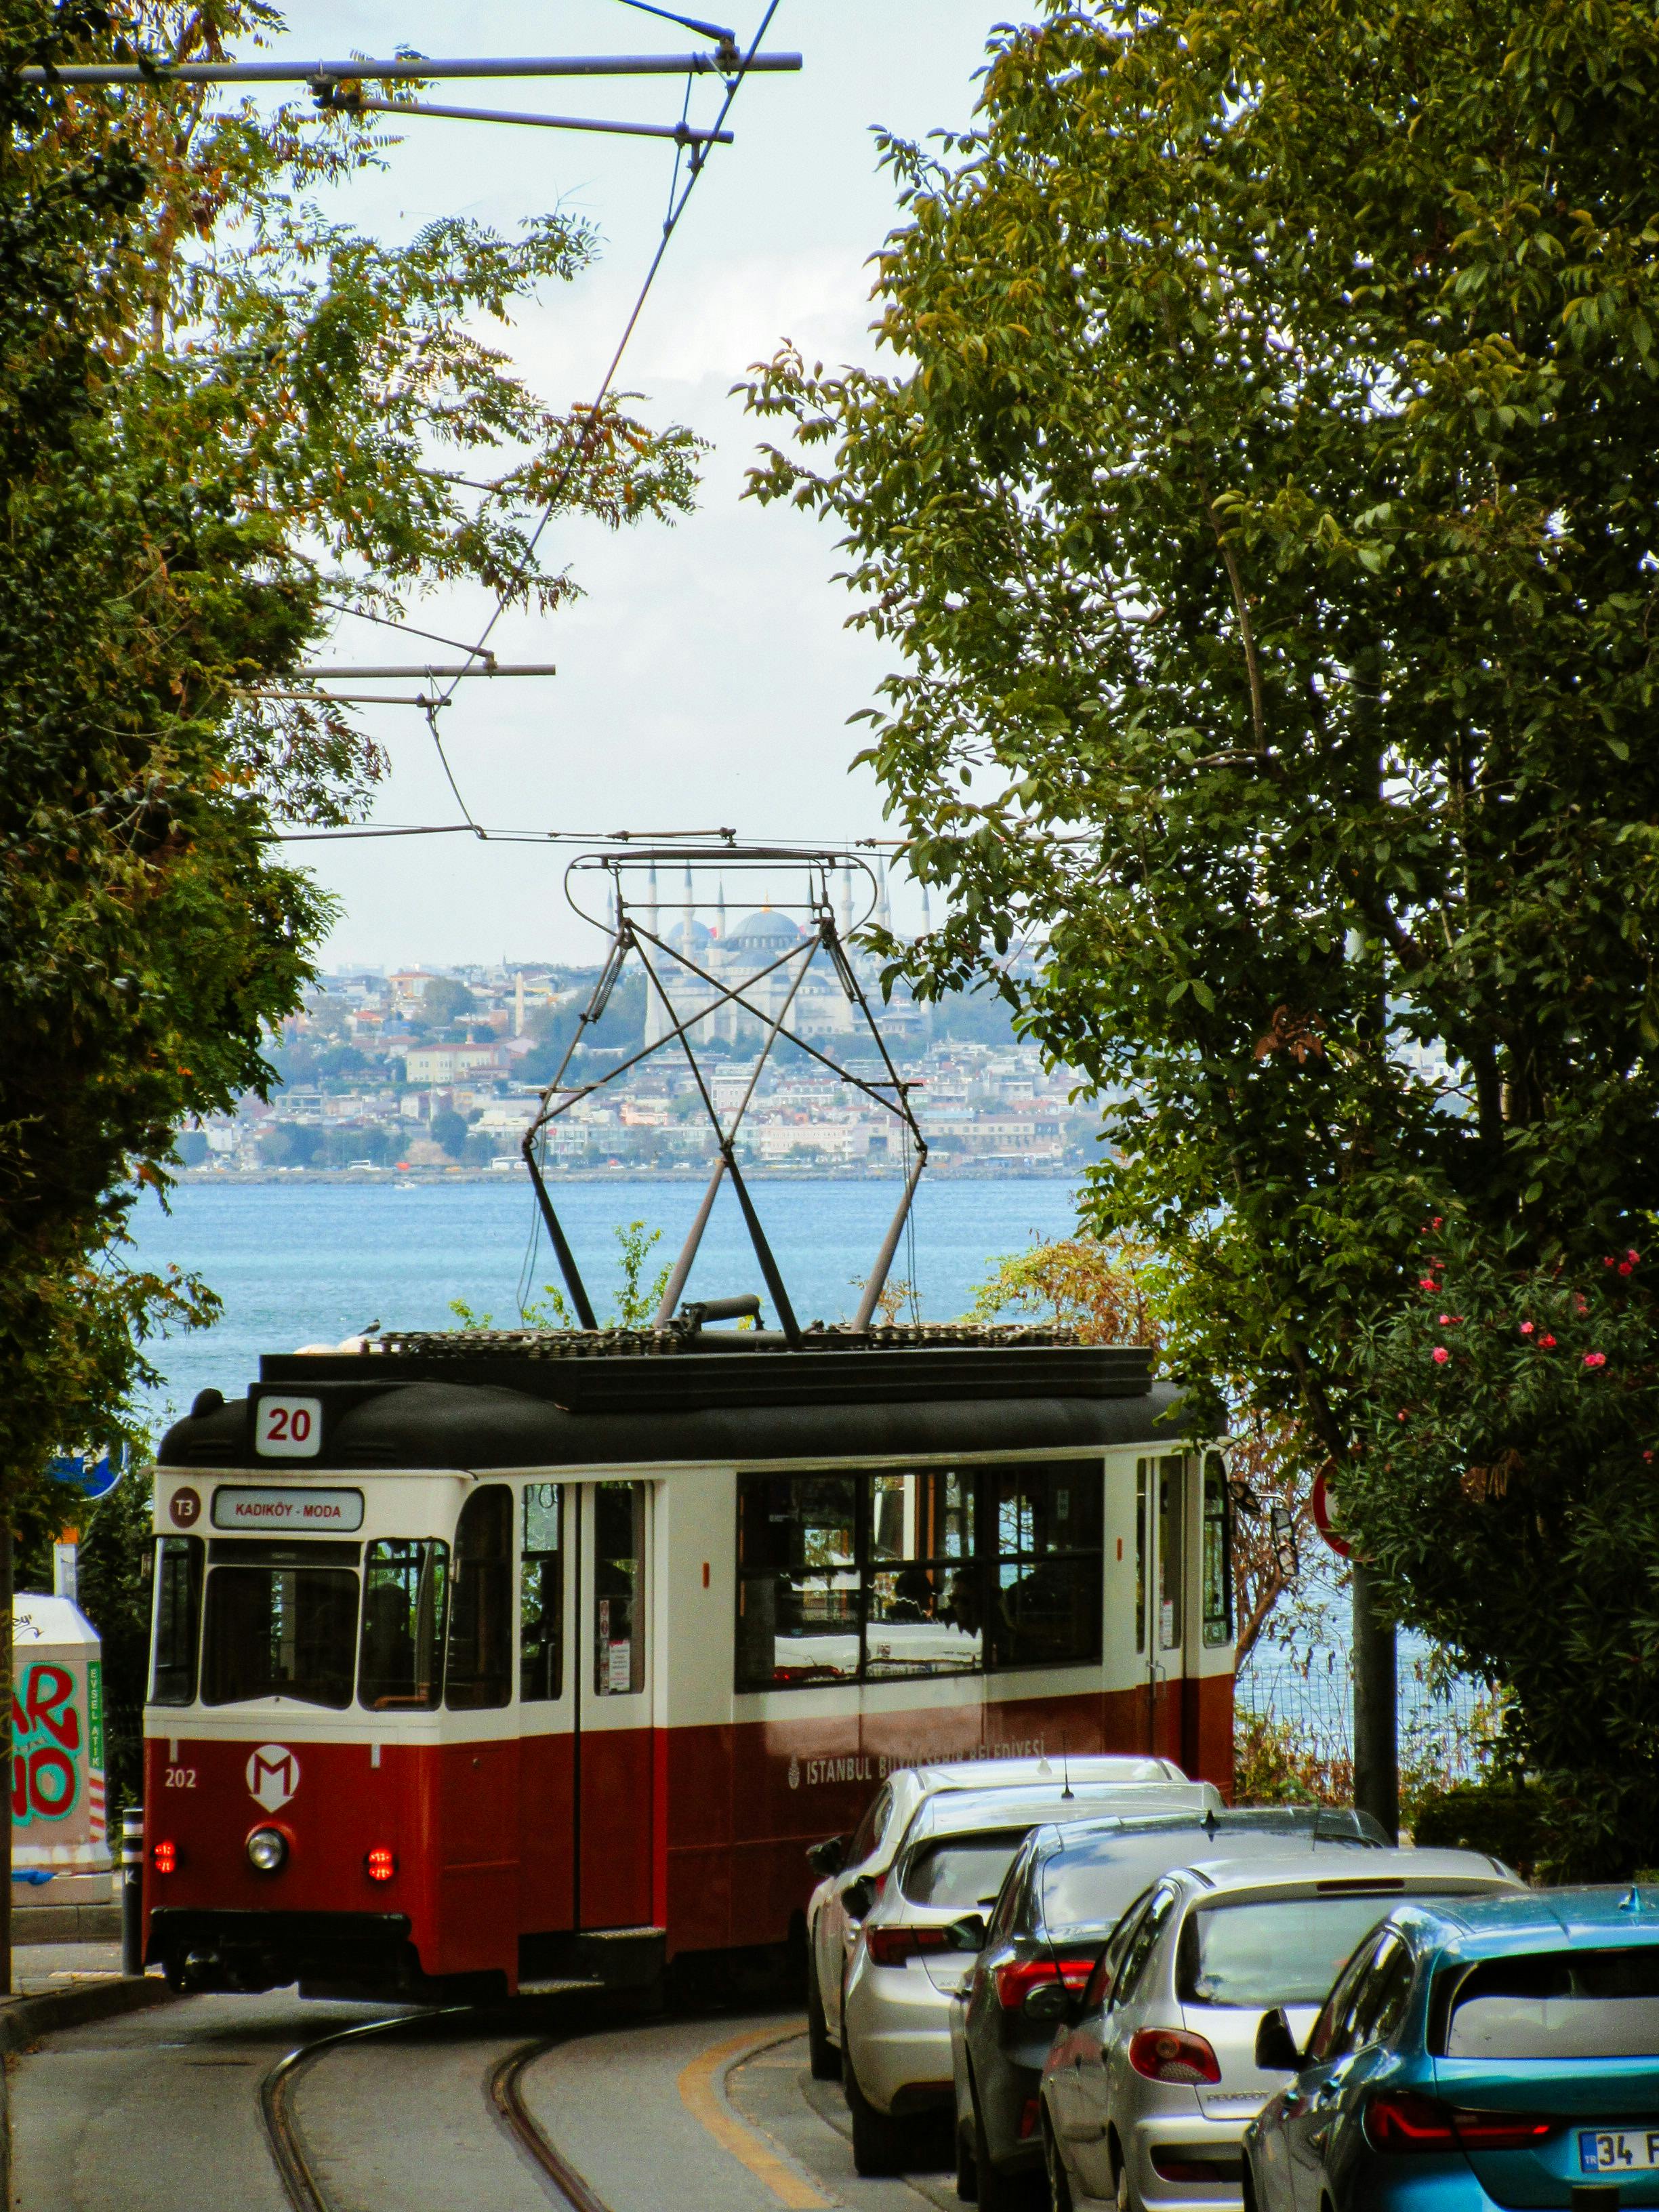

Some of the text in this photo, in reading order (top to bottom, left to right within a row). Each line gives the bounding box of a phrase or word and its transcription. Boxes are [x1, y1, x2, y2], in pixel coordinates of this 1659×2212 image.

[267, 1408, 311, 1441] 20
[175, 1499, 193, 1516] T3
[235, 1501, 293, 1517] KADIKÖY
[303, 1504, 341, 1518] MODA
[90, 1668, 98, 1720] EVSEL
[165, 1769, 197, 1788] 202
[253, 1753, 292, 1796] M
[1597, 2135, 1633, 2165] 34
